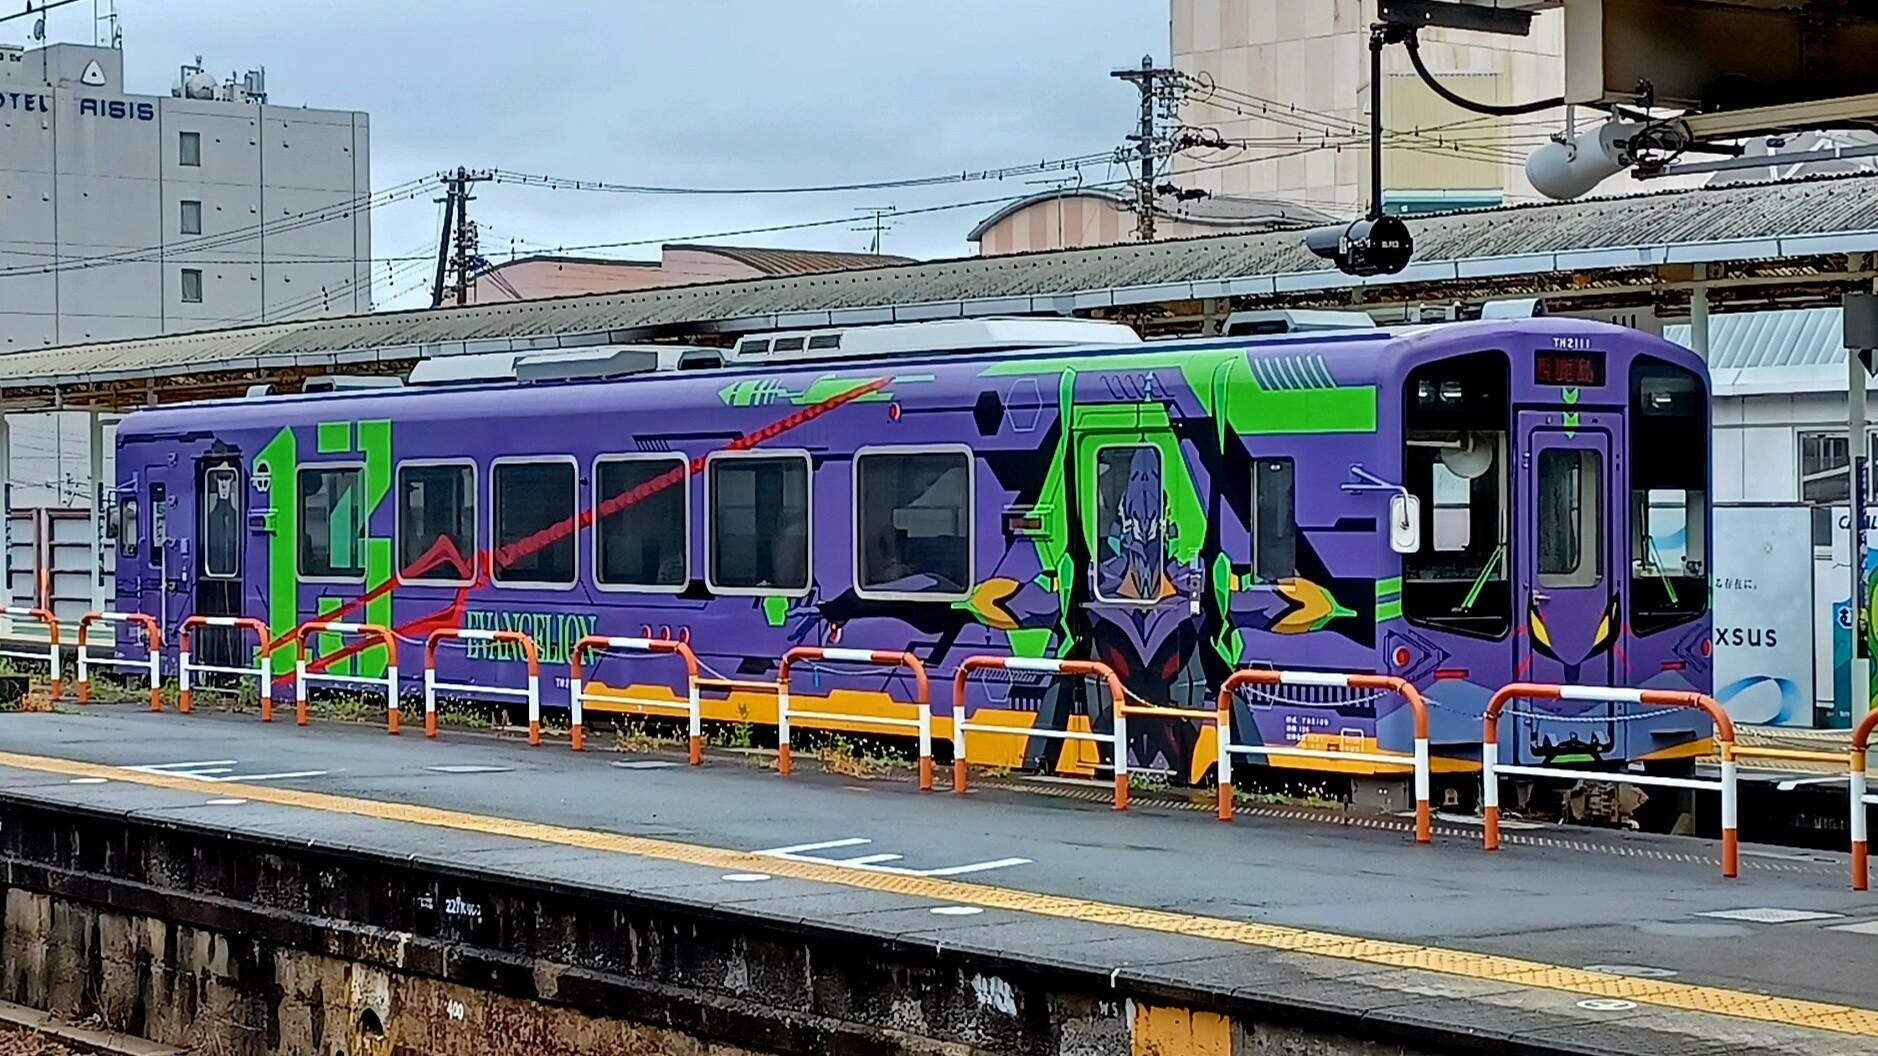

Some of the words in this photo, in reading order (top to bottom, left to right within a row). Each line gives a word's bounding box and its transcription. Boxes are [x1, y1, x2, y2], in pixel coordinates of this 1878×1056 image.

[80, 98, 154, 121] AISIS
[1552, 337, 1591, 349] TH2111
[466, 610, 598, 666] EVANGELION
